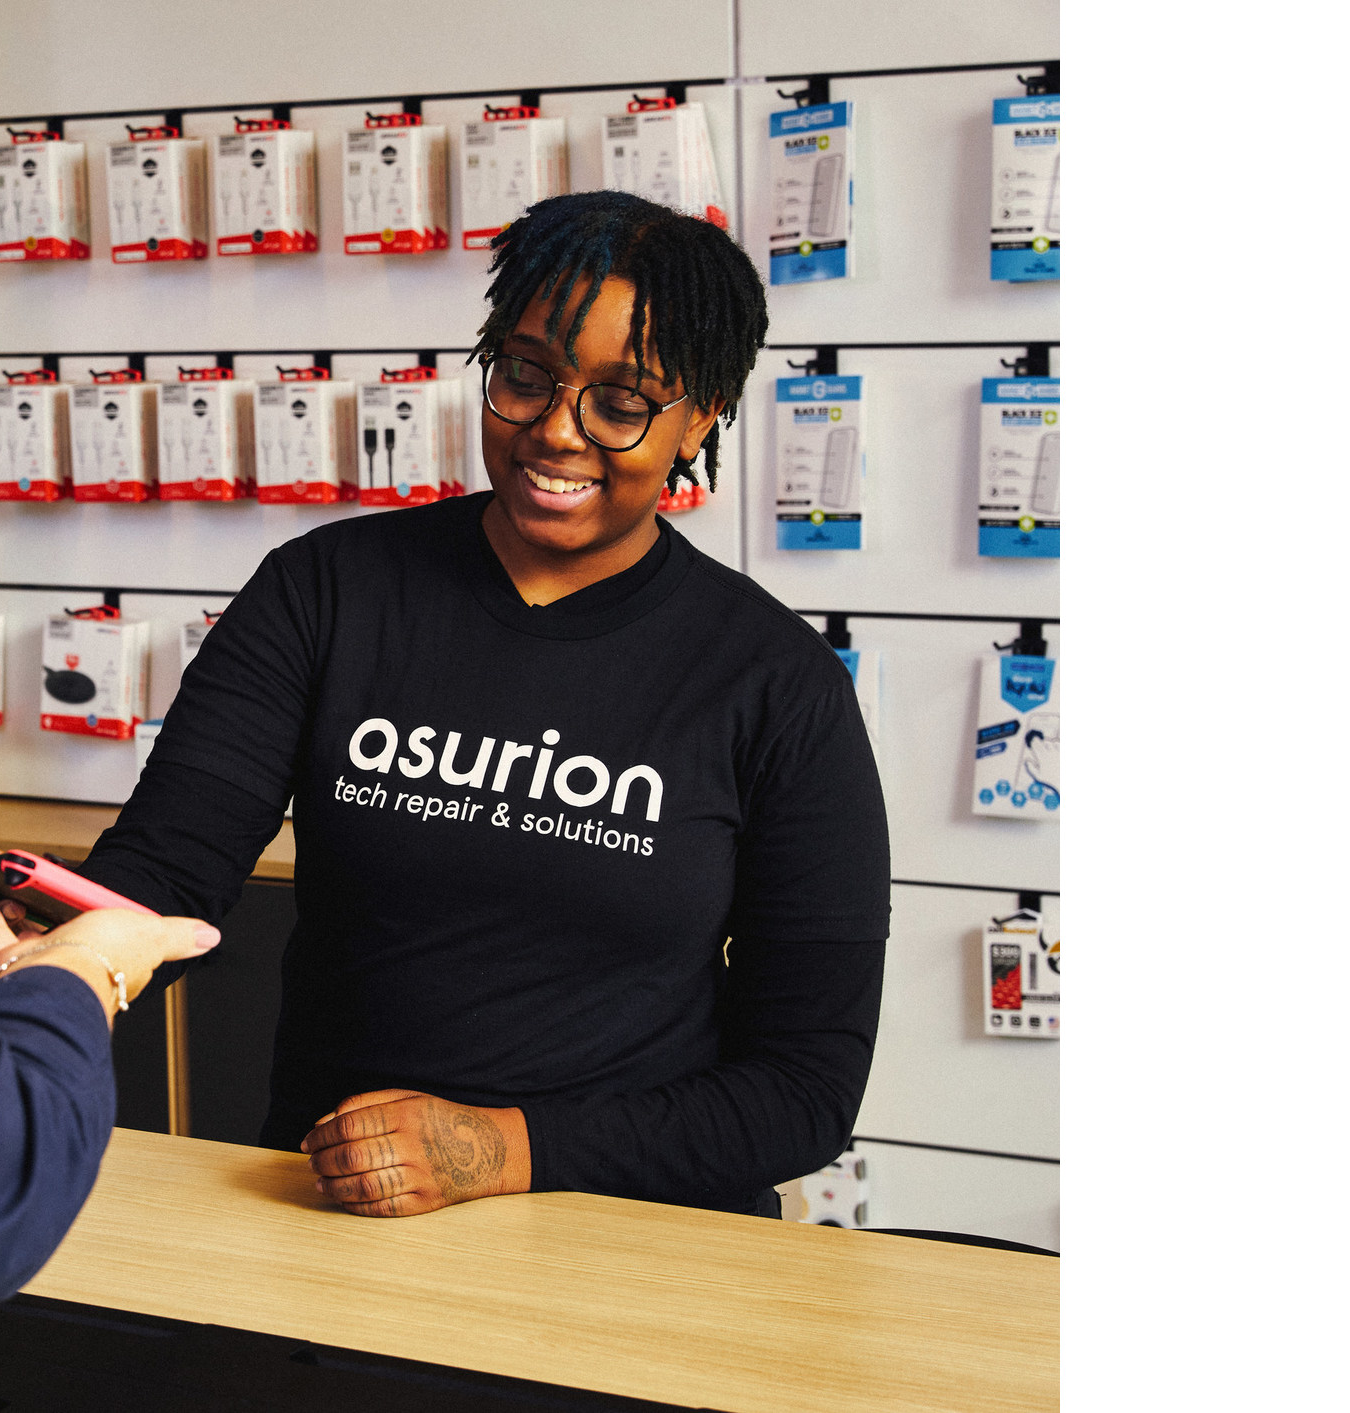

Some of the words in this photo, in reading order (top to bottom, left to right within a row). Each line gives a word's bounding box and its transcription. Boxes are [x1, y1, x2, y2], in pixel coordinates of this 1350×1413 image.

[334, 775, 388, 809] tech
[393, 792, 484, 822] repair
[490, 802, 511, 828] &
[520, 812, 655, 857] solutions
[348, 717, 664, 823] asurion
